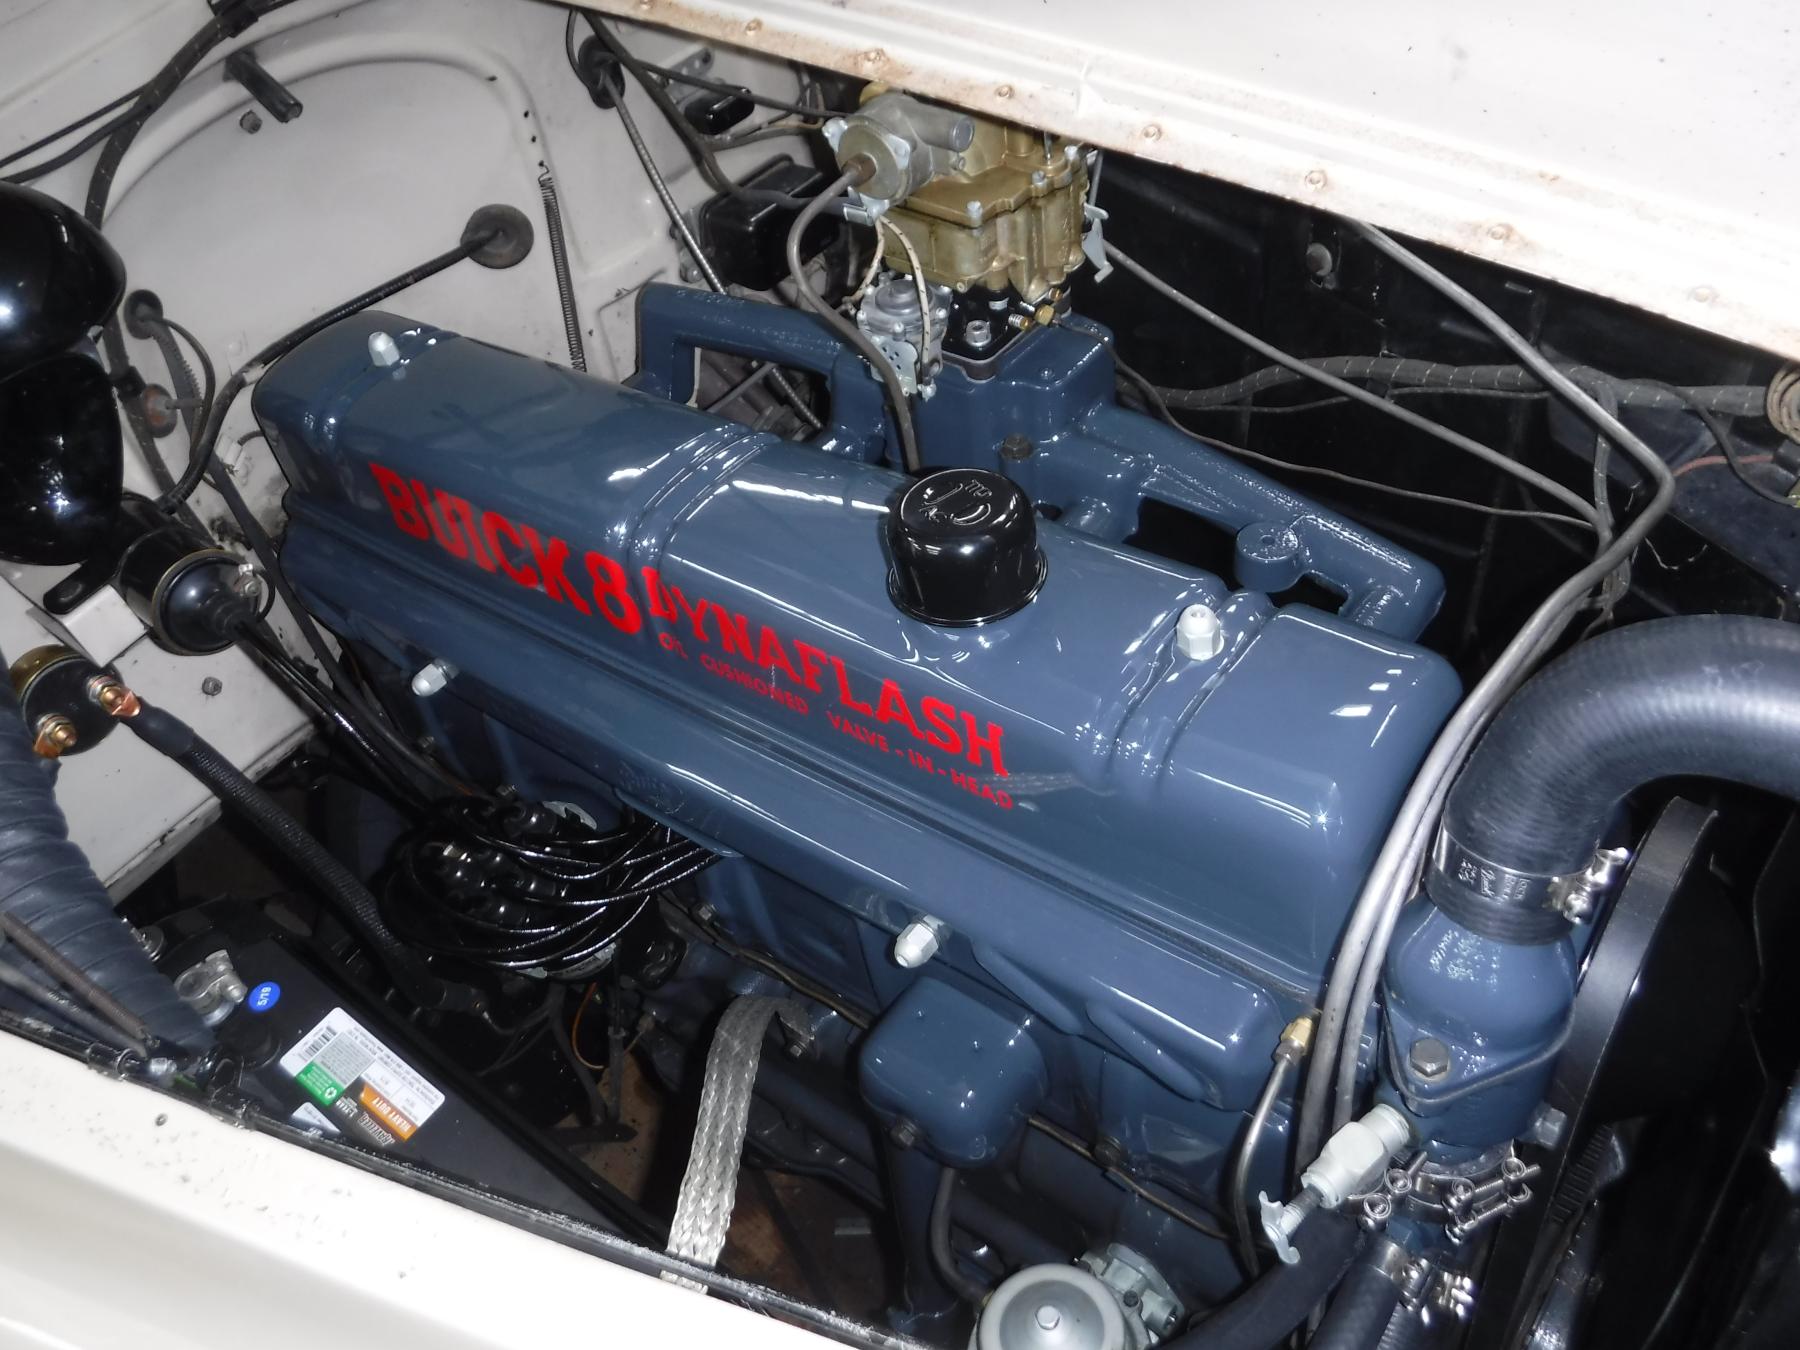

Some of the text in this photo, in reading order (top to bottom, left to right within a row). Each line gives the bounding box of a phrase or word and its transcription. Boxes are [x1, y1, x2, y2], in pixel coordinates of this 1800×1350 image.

[368, 461, 1009, 778] BUICK 8 DYNAFLASH
[658, 631, 689, 660] OIL
[701, 654, 809, 715] CUSHIONED
[371, 1096, 392, 1116] DUTY
[387, 1111, 412, 1133] HEAVY
